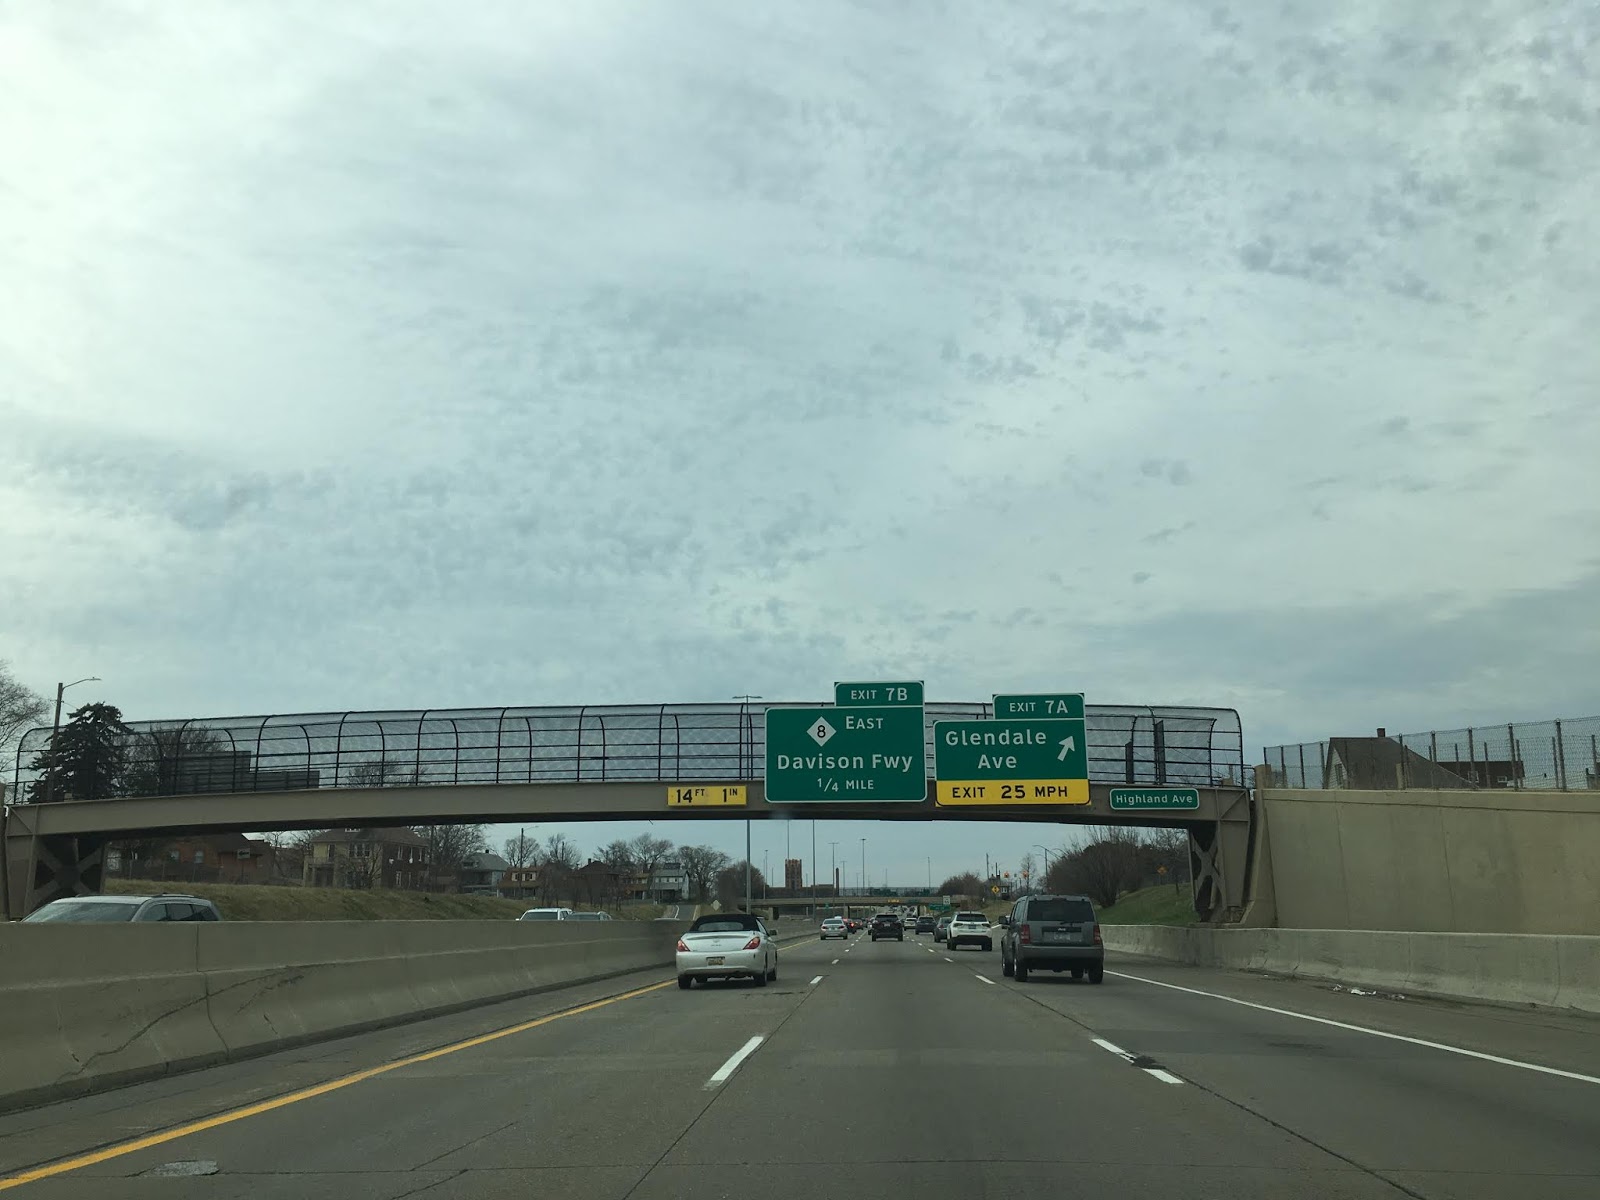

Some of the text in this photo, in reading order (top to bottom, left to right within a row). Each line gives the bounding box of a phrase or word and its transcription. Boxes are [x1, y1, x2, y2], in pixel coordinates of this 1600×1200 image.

[851, 687, 908, 701] EXIT 7B
[1009, 700, 1069, 714] EXIT 7A
[845, 716, 884, 730] EAST
[816, 724, 826, 738] 8
[945, 729, 1047, 746] Glendale
[777, 753, 913, 773] Davison Fwy
[977, 754, 1017, 769] Ave
[817, 777, 874, 792] 1/4 MILE
[676, 788, 693, 803] 14
[952, 785, 1068, 799] EXIT 25 MPH
[1116, 794, 1193, 805] Highland Ave
